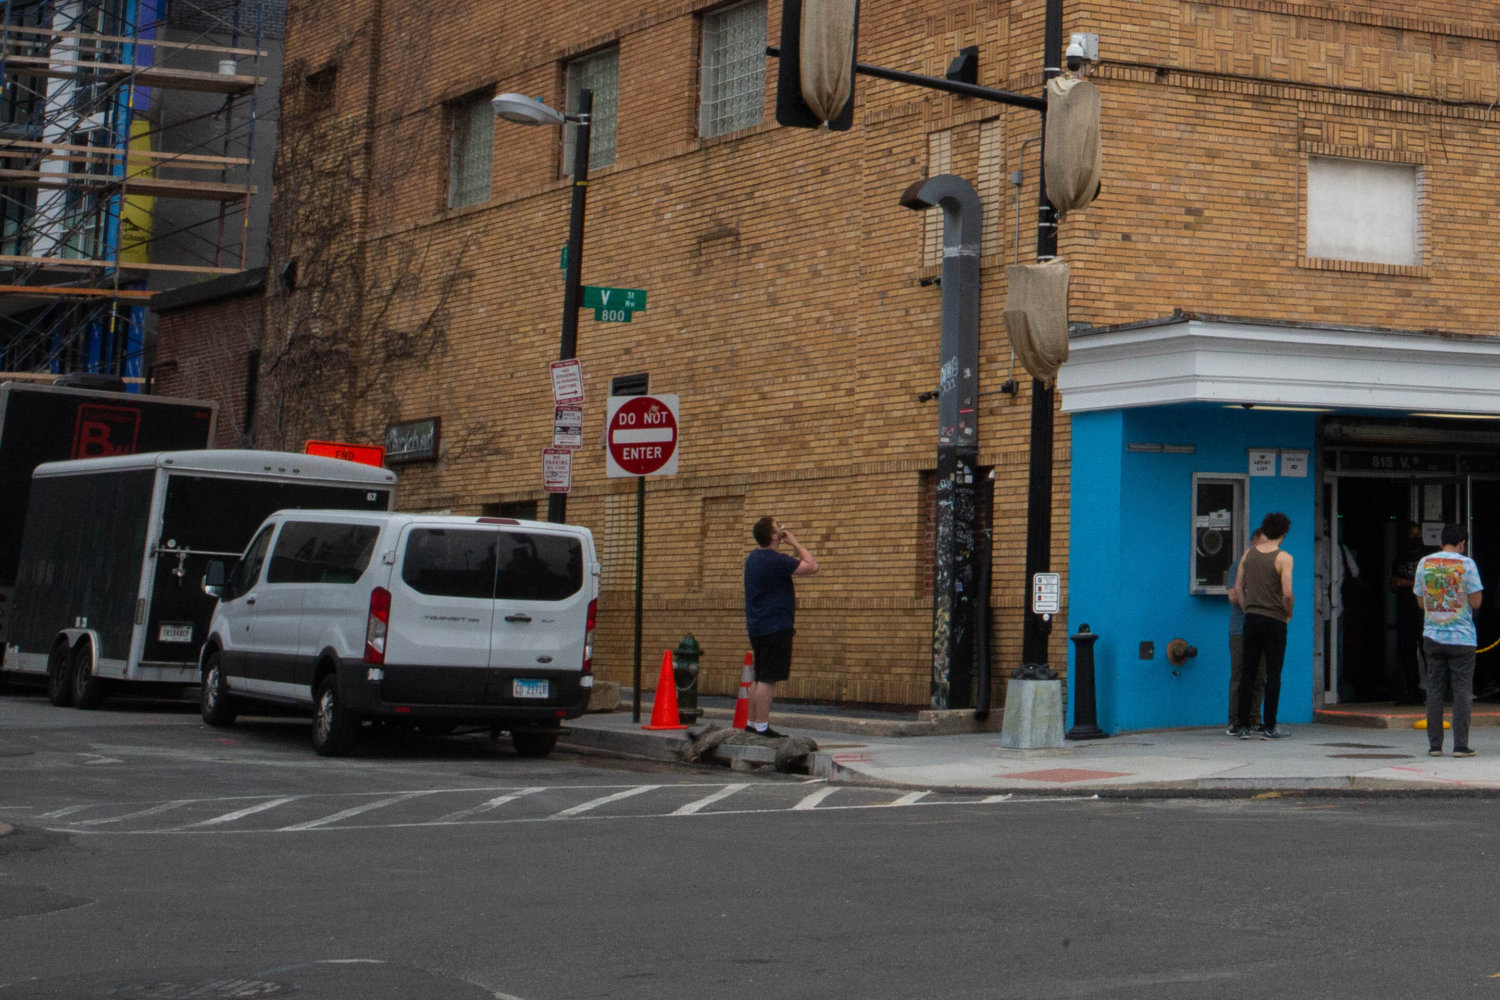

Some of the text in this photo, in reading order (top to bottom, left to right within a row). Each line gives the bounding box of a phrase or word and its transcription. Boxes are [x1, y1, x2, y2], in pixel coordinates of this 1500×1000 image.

[601, 290, 635, 306] V St
[602, 310, 625, 321] 800
[619, 411, 668, 425] DO NOT
[335, 451, 355, 462] END
[623, 446, 662, 460] ENTER
